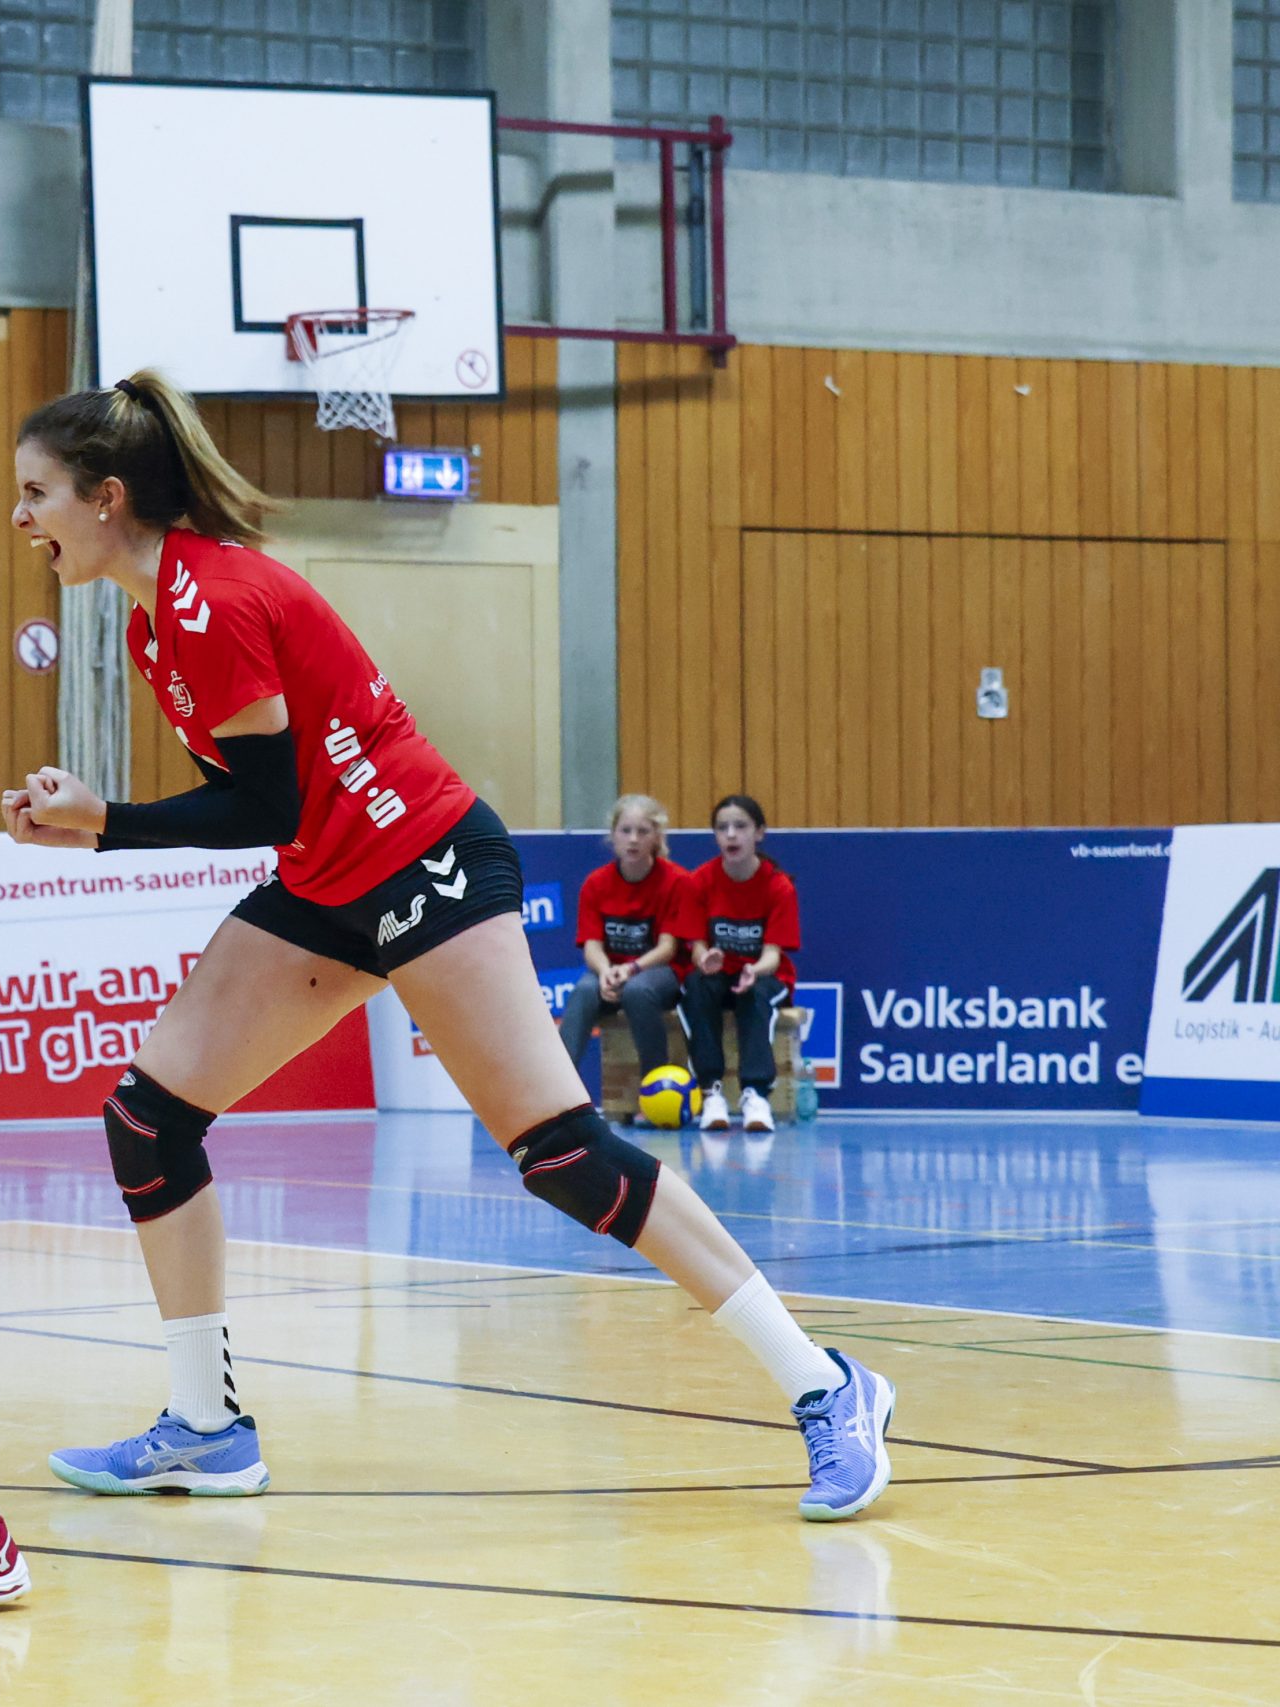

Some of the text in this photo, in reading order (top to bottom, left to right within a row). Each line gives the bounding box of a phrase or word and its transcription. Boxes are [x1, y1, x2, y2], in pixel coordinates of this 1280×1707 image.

[98, 963, 162, 1000] an
[860, 985, 1108, 1029] Volksbank
[1174, 1019, 1240, 1045] Logistik
[858, 1040, 1100, 1085] Sauerland
